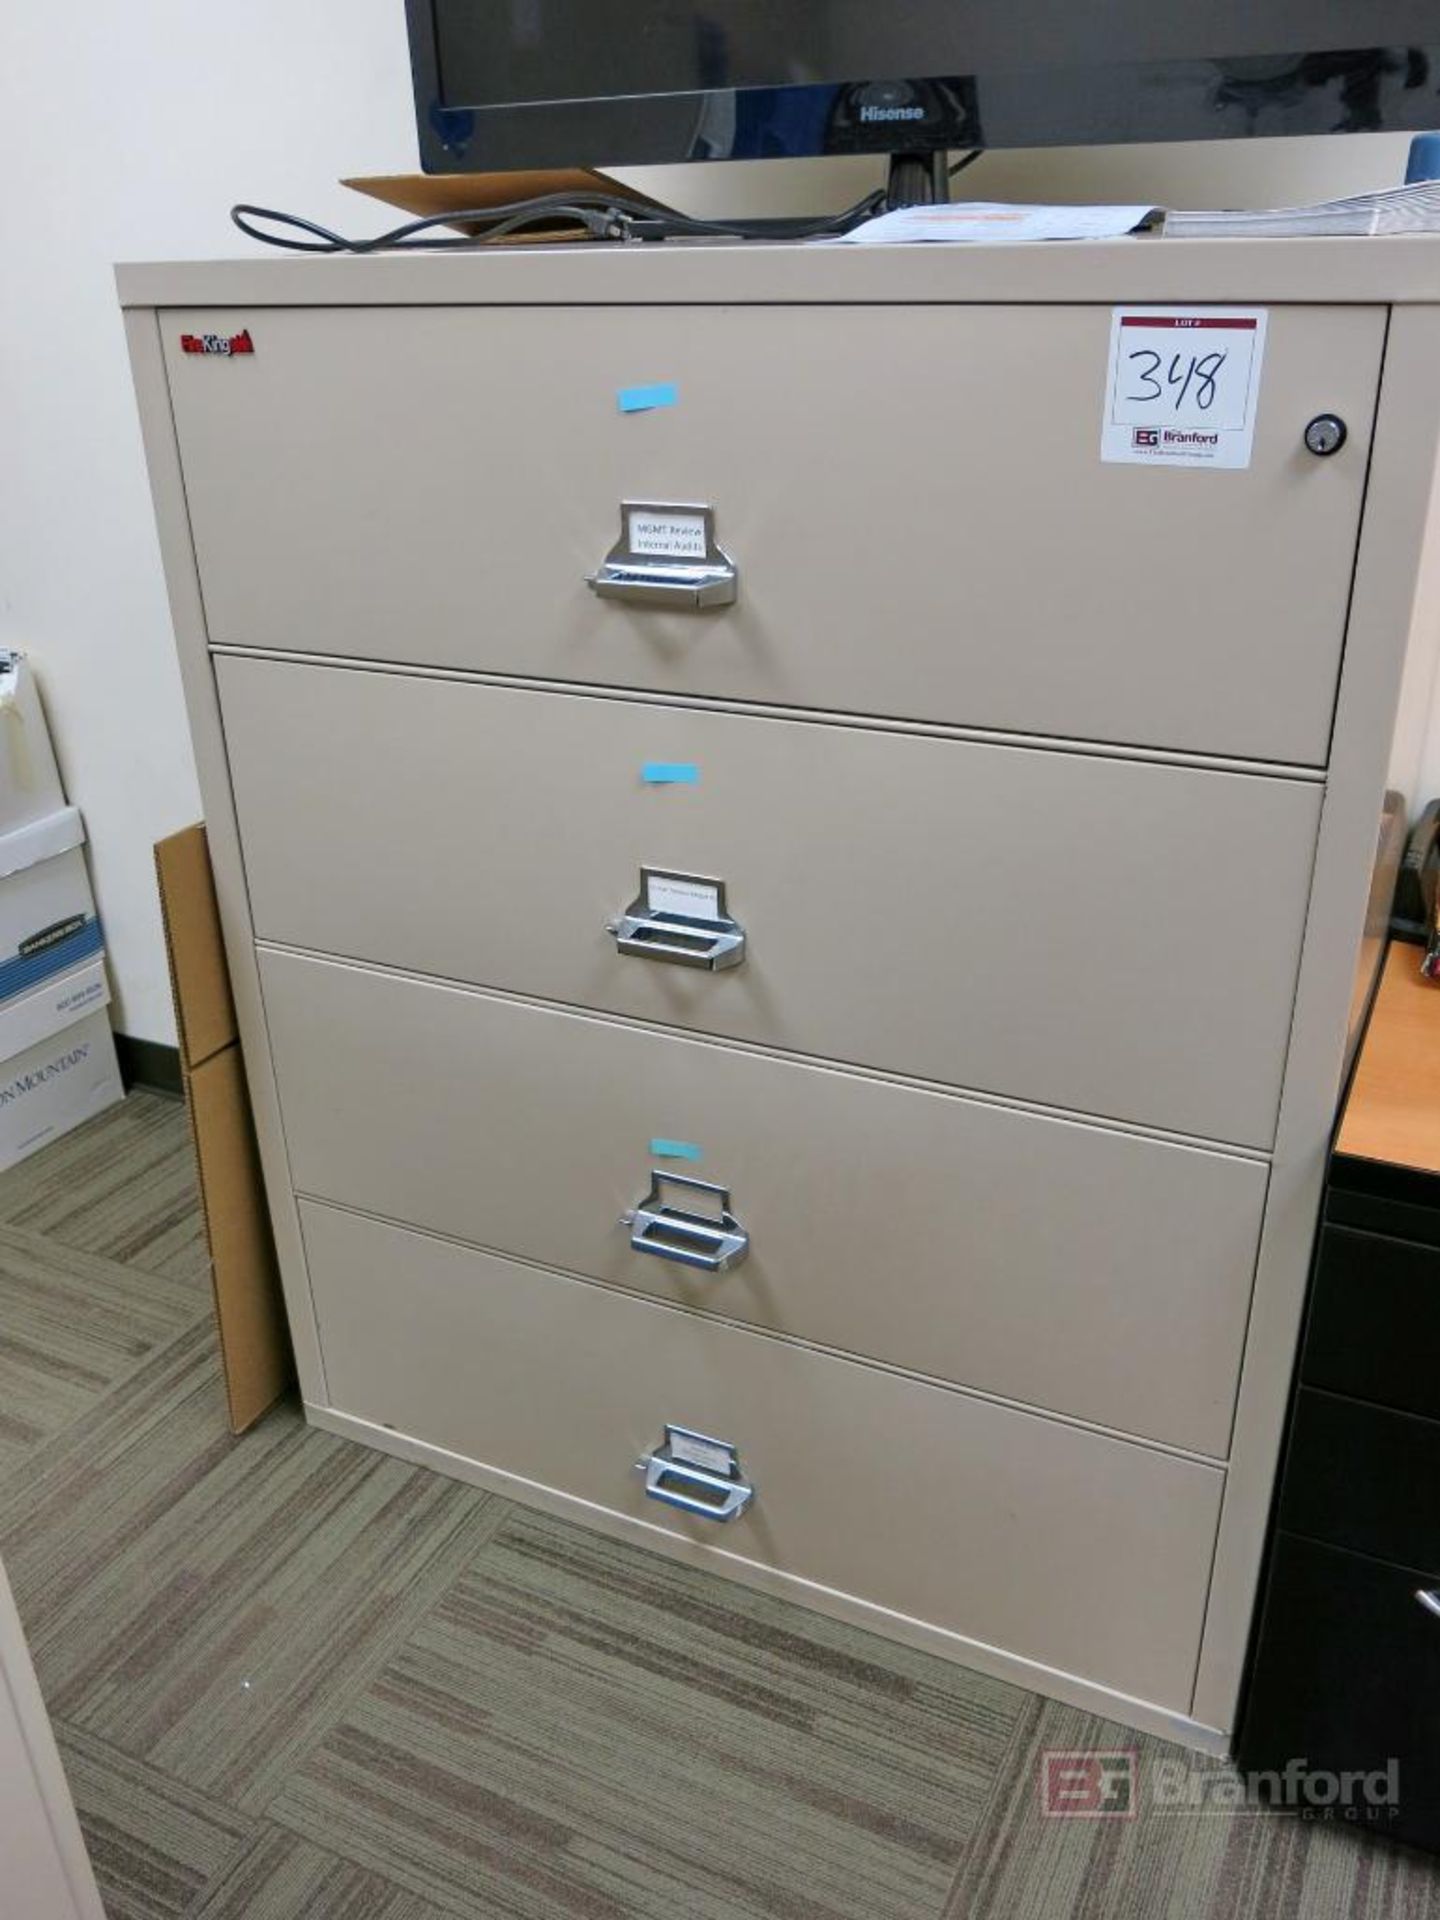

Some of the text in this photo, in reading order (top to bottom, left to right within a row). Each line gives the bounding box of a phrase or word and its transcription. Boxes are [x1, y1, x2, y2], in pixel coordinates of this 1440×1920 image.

[861, 106, 924, 121] Hisense
[1174, 319, 1193, 327] LOT
[1127, 350, 1227, 410] 348
[1164, 429, 1218, 445] Branford
[637, 524, 702, 537] MGMT Review
[638, 539, 672, 551] Internal
[16, 1046, 89, 1093] MOUNTAIN
